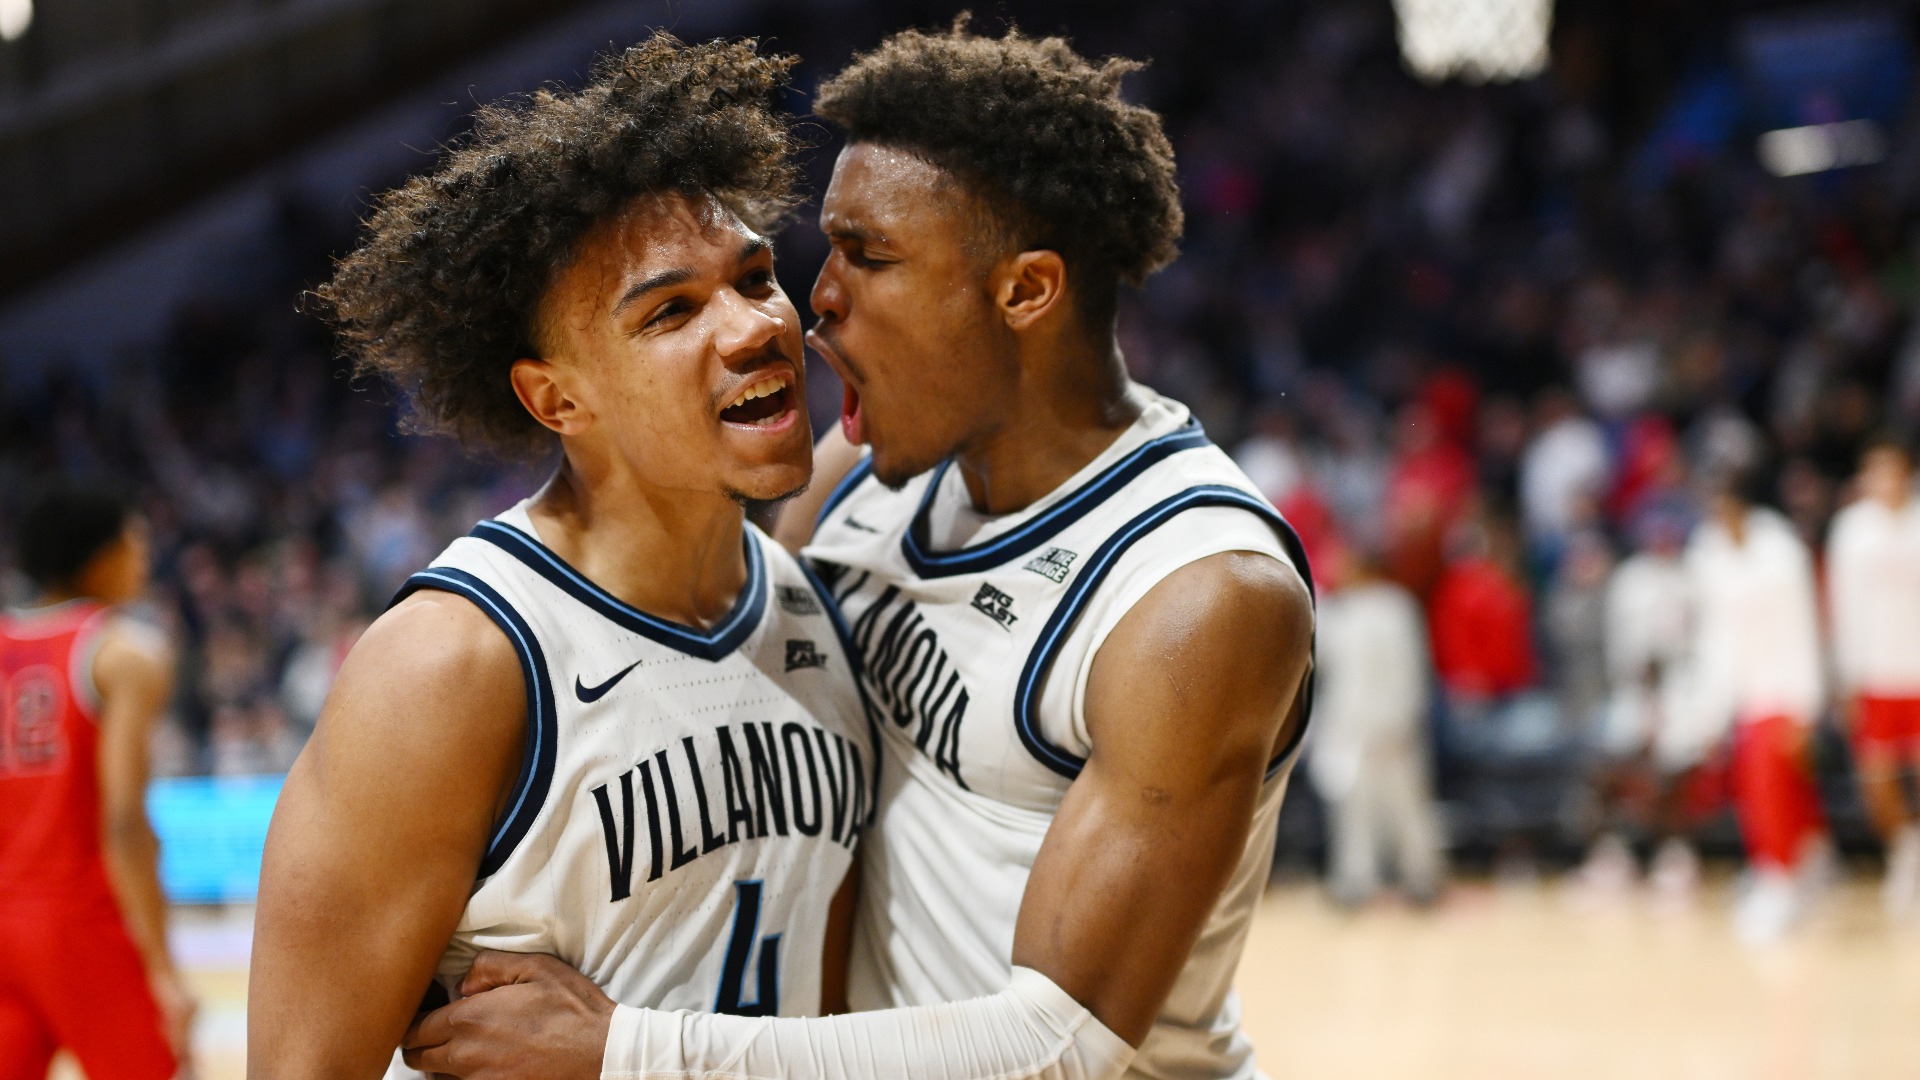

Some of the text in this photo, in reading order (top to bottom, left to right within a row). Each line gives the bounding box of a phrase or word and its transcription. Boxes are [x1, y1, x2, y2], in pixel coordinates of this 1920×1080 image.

[973, 592, 1019, 626] EAST
[979, 582, 1014, 608] BIG
[590, 721, 867, 903] VILLANOVA
[712, 879, 784, 1018] 4
